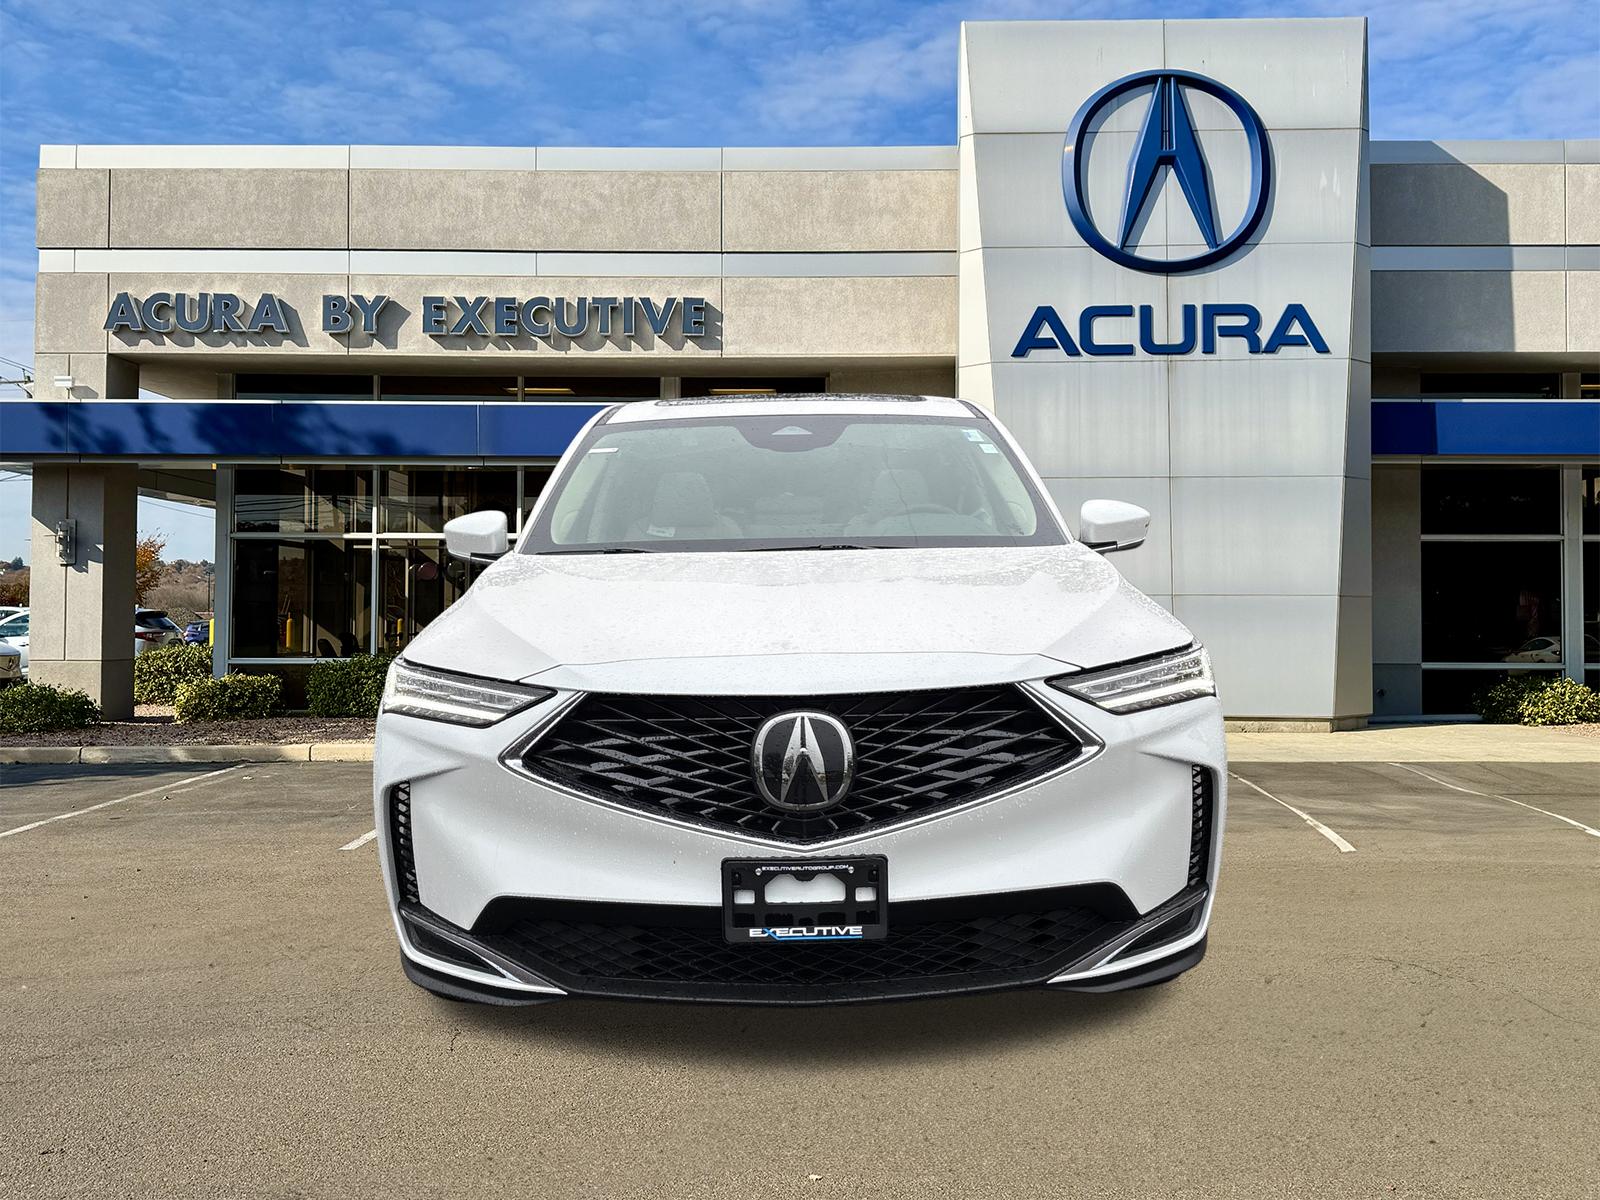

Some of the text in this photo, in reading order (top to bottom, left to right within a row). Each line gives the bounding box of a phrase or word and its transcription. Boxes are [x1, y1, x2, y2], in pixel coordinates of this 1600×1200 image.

[103, 291, 707, 336] ACURA BY EXECUTIVE
[1010, 303, 1332, 357] ACURA
[761, 864, 849, 872] EXECUTIVEAUTOGROUP.COM
[749, 926, 863, 939] EXECUTIVE
